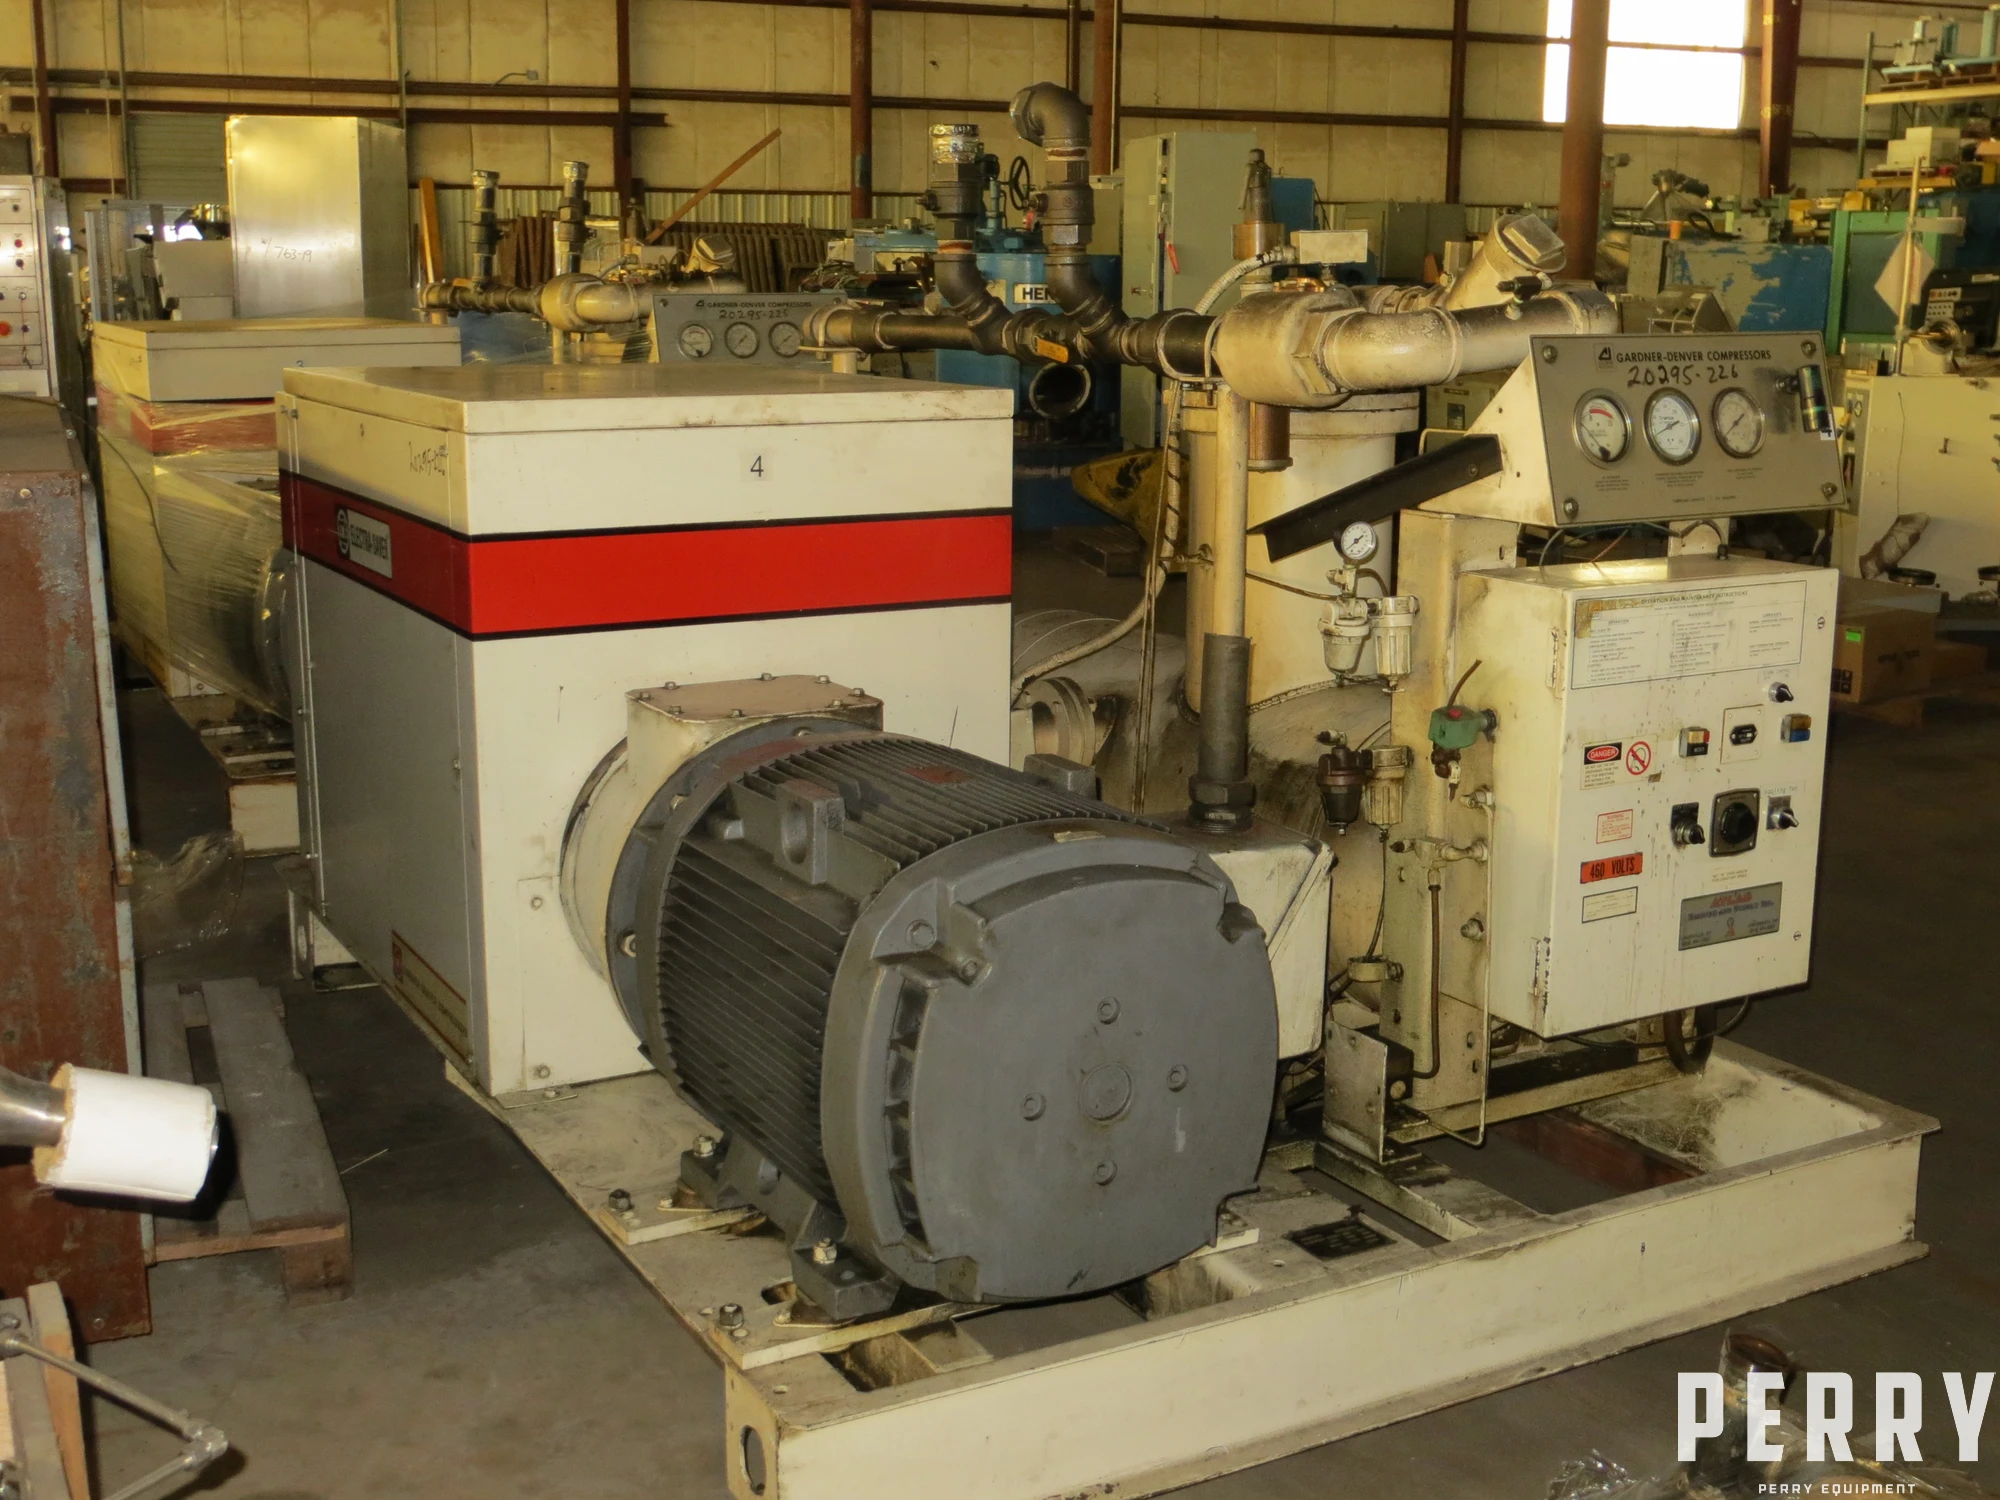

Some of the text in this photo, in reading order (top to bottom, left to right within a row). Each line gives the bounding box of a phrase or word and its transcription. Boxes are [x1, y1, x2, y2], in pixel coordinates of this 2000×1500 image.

[1616, 349, 1772, 363] GARDNER-DENVER COMPRESSORS
[750, 455, 764, 477] 4
[1590, 748, 1616, 758] DANGER
[1590, 856, 1635, 878] 460 VOLTS
